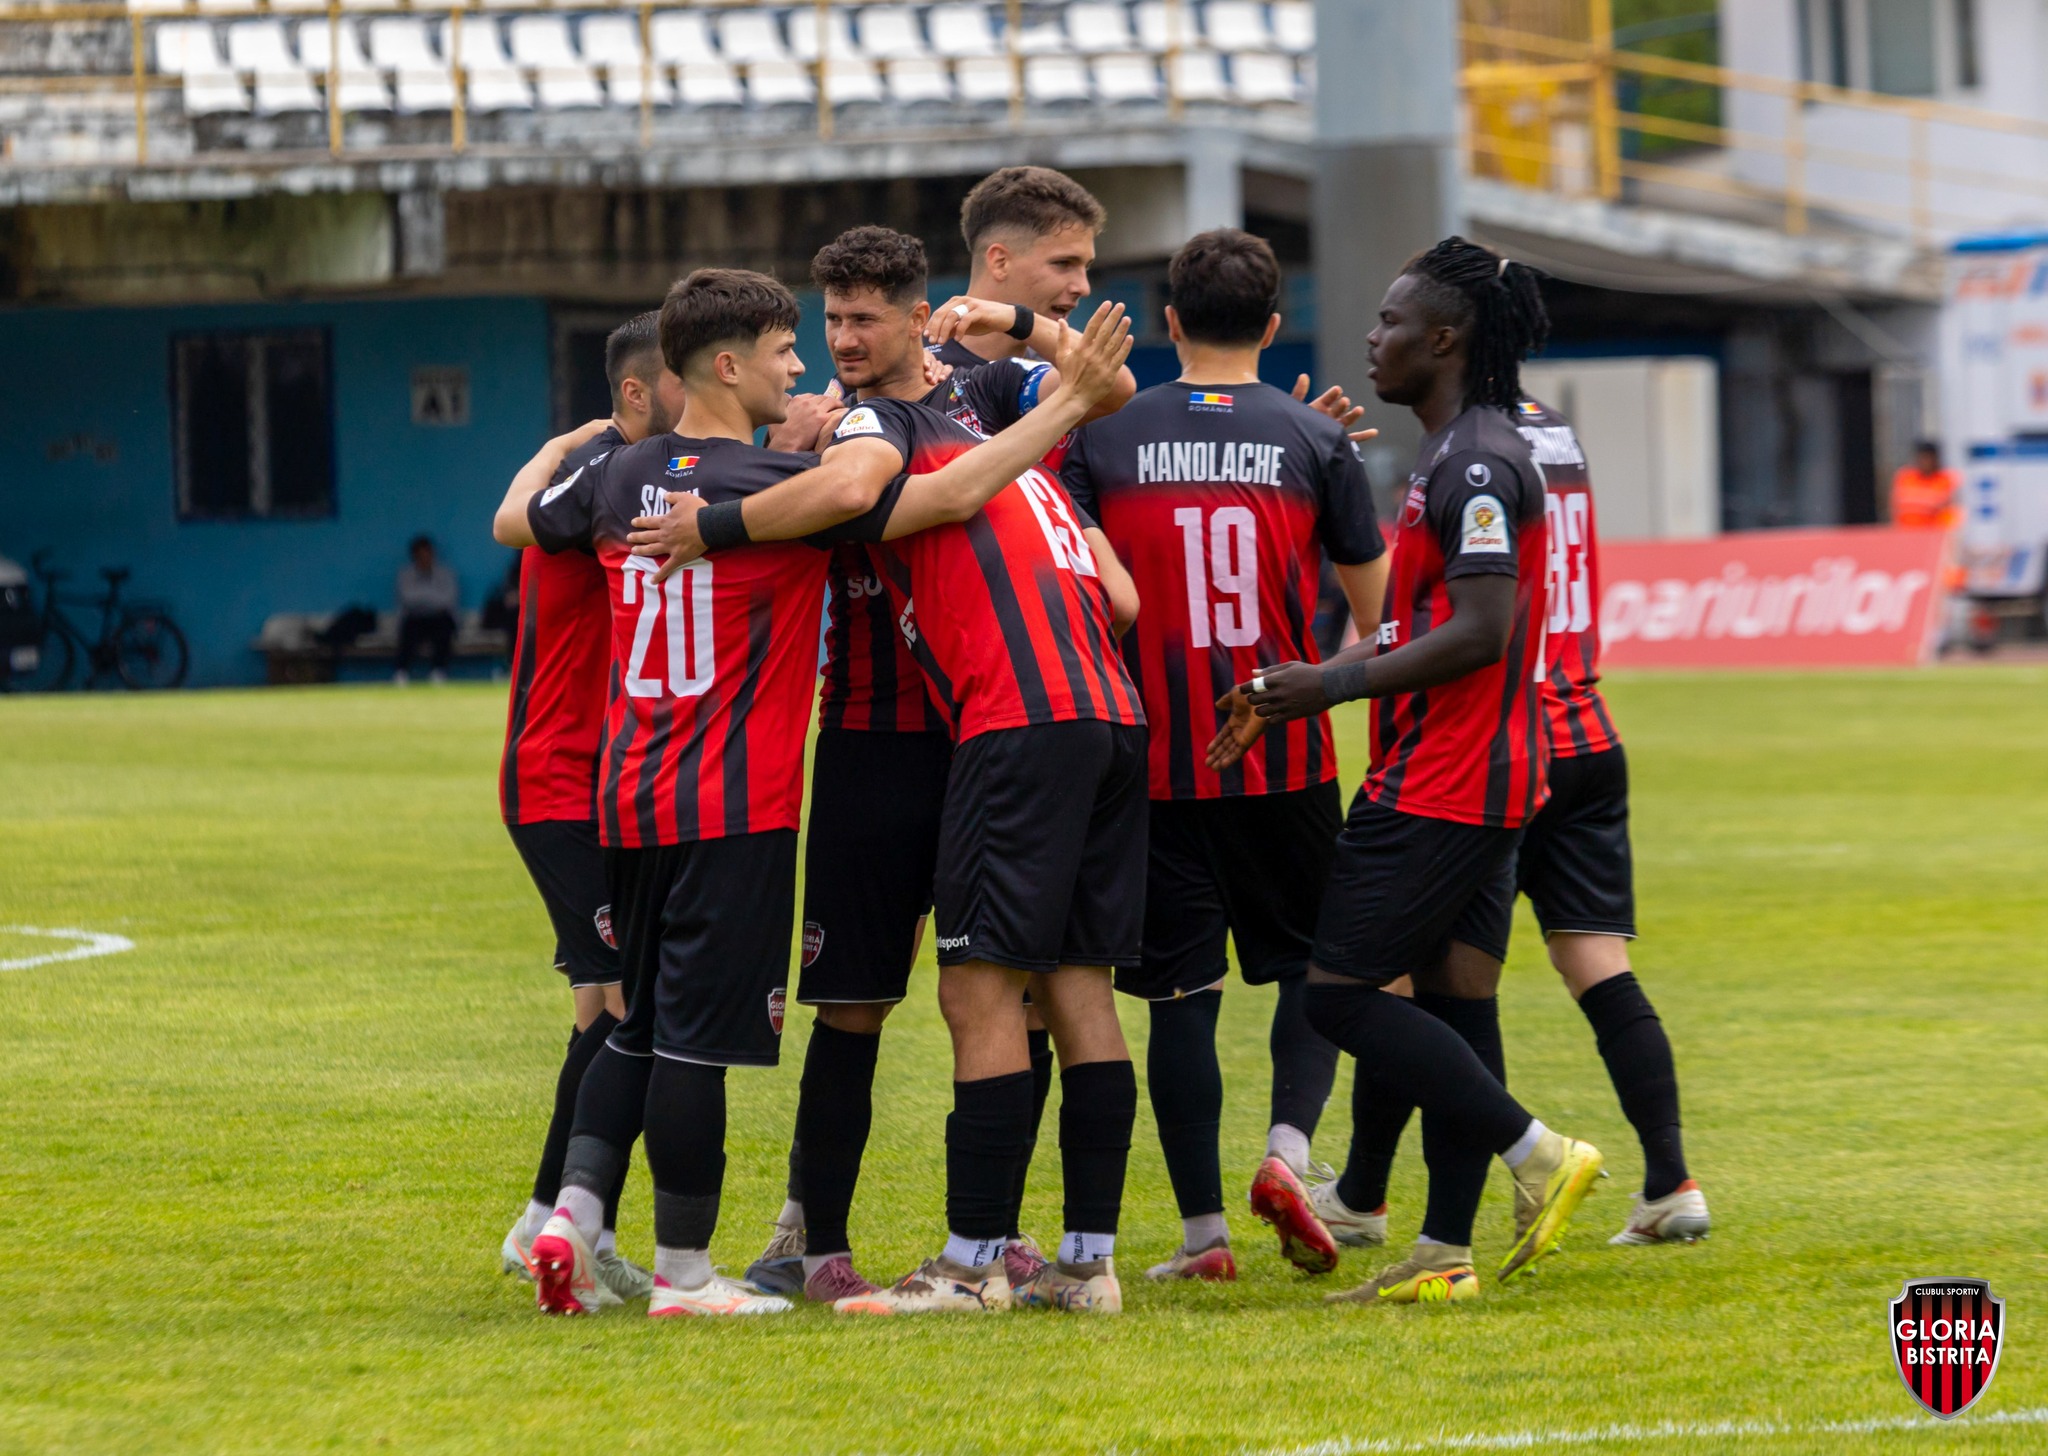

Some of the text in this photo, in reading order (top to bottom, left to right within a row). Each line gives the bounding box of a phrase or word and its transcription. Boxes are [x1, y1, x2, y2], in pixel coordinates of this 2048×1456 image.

[1015, 467, 1098, 578] 13
[1137, 441, 1286, 487] MANOLACHE
[620, 553, 716, 698] 20
[1173, 505, 1262, 649] 19
